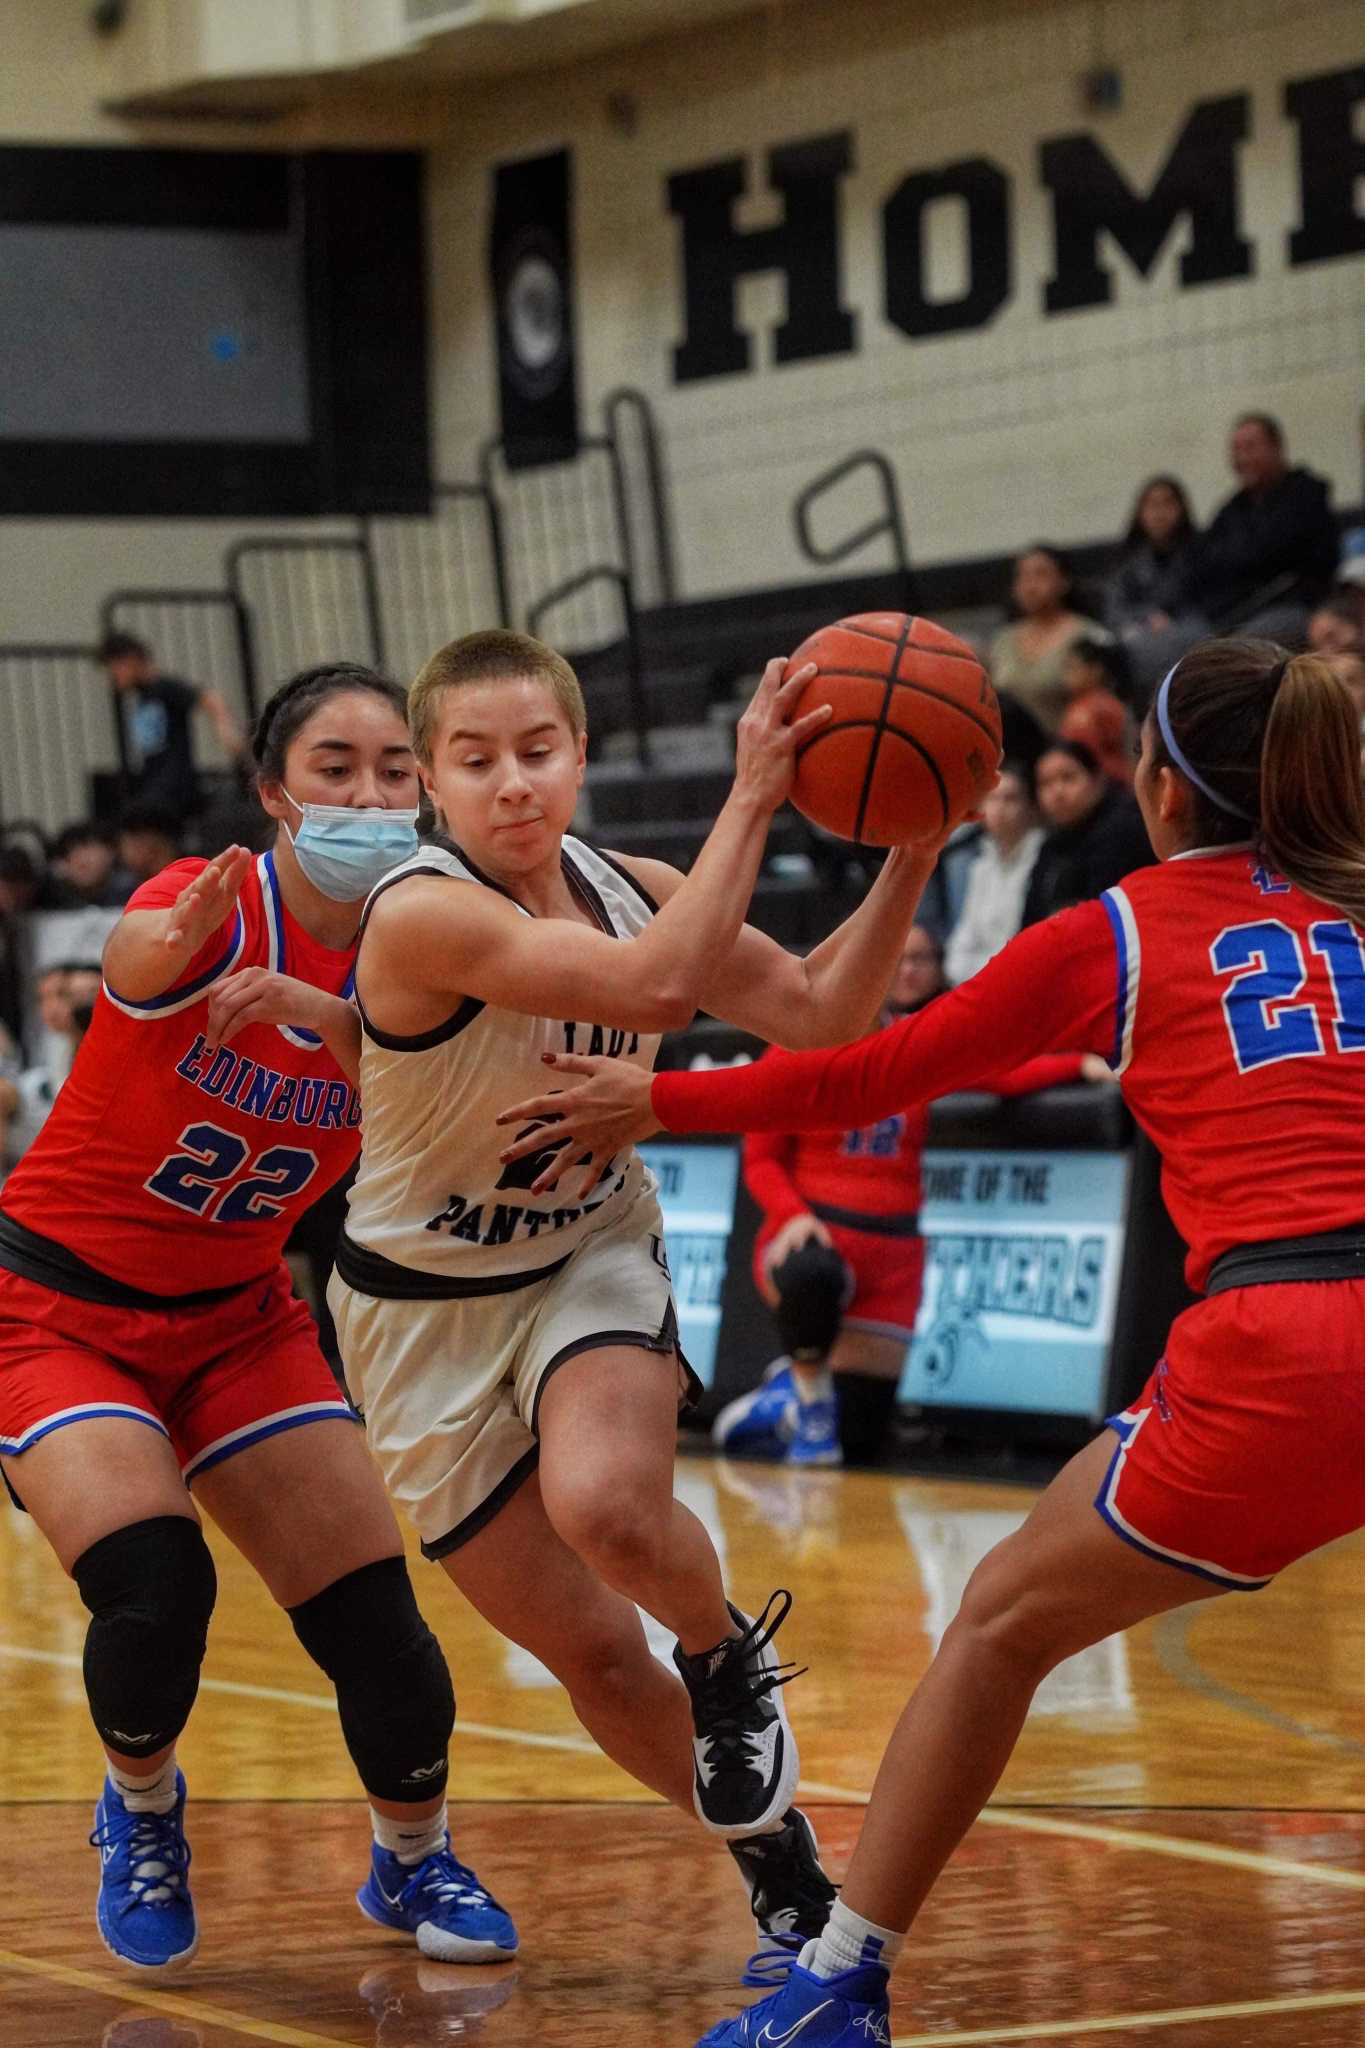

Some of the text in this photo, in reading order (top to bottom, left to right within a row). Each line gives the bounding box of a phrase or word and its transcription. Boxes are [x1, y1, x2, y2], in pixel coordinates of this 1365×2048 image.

[1208, 918, 1365, 1074] 21
[143, 1121, 319, 1222] 22
[1009, 1163, 1052, 1205] THE
